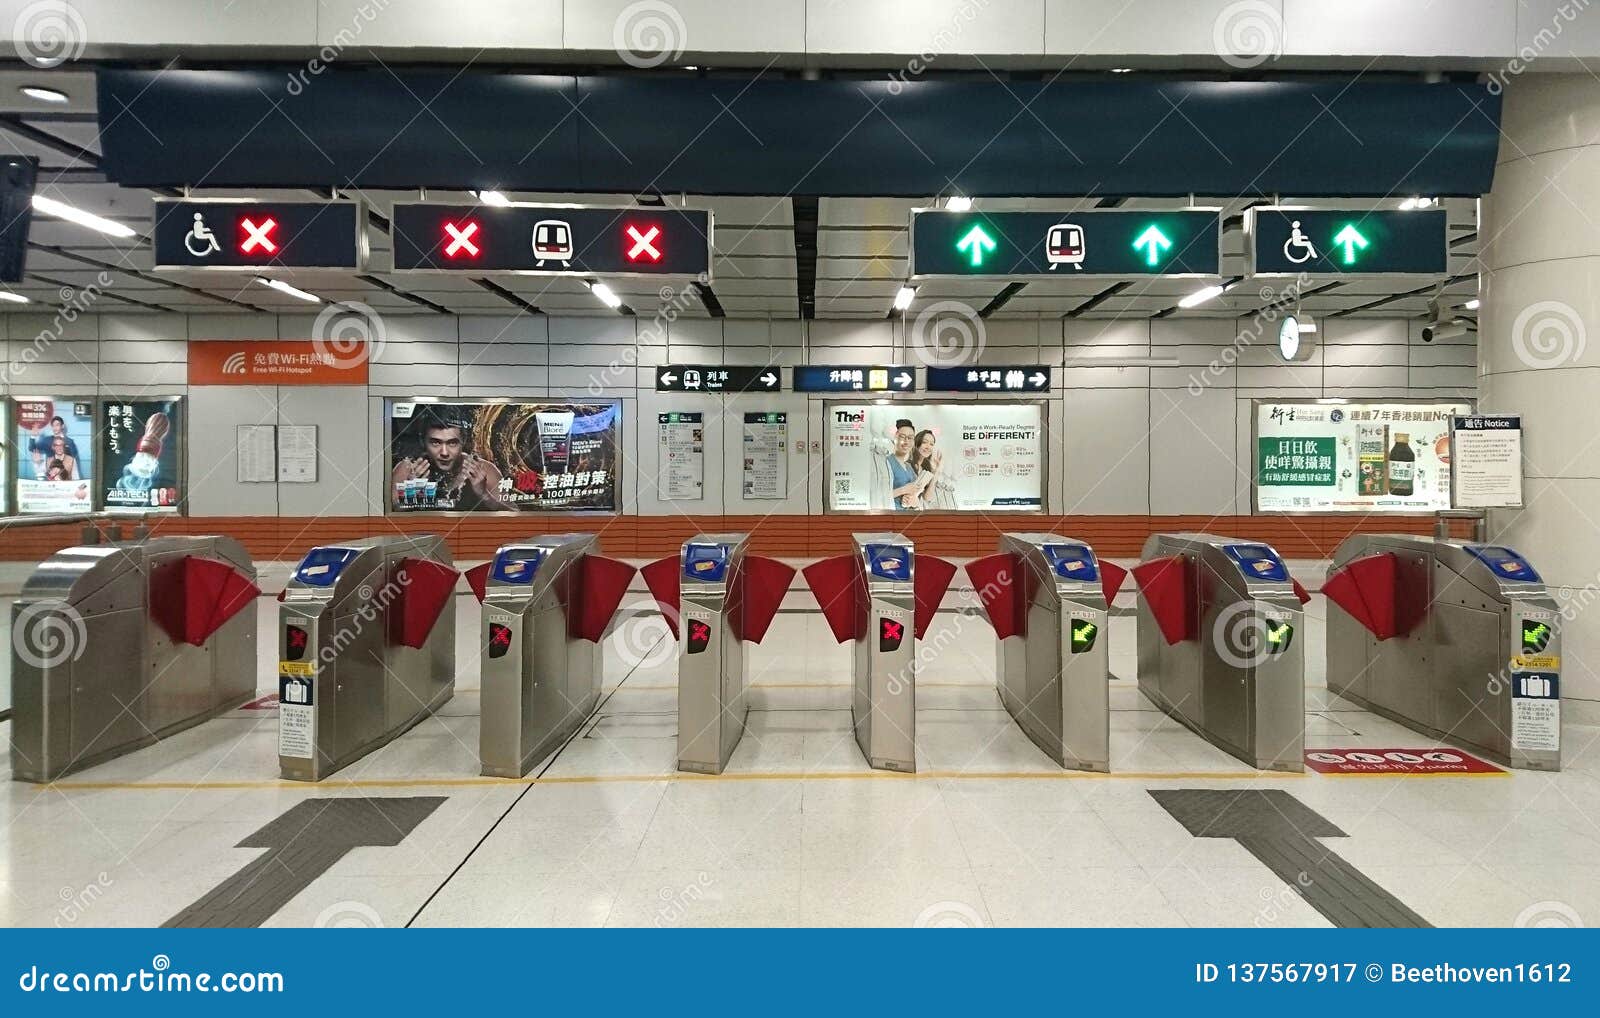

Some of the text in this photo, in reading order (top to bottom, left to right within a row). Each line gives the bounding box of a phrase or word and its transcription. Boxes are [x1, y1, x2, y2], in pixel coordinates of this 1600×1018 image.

[707, 371, 729, 381] 列車
[829, 370, 863, 382] 升降機
[123, 405, 134, 433] 男を、
[1484, 419, 1510, 428] Notice
[108, 405, 120, 454] 楽しもう。
[963, 431, 1035, 440] BE DiFFERENT!
[1279, 441, 1318, 454] 日日飲
